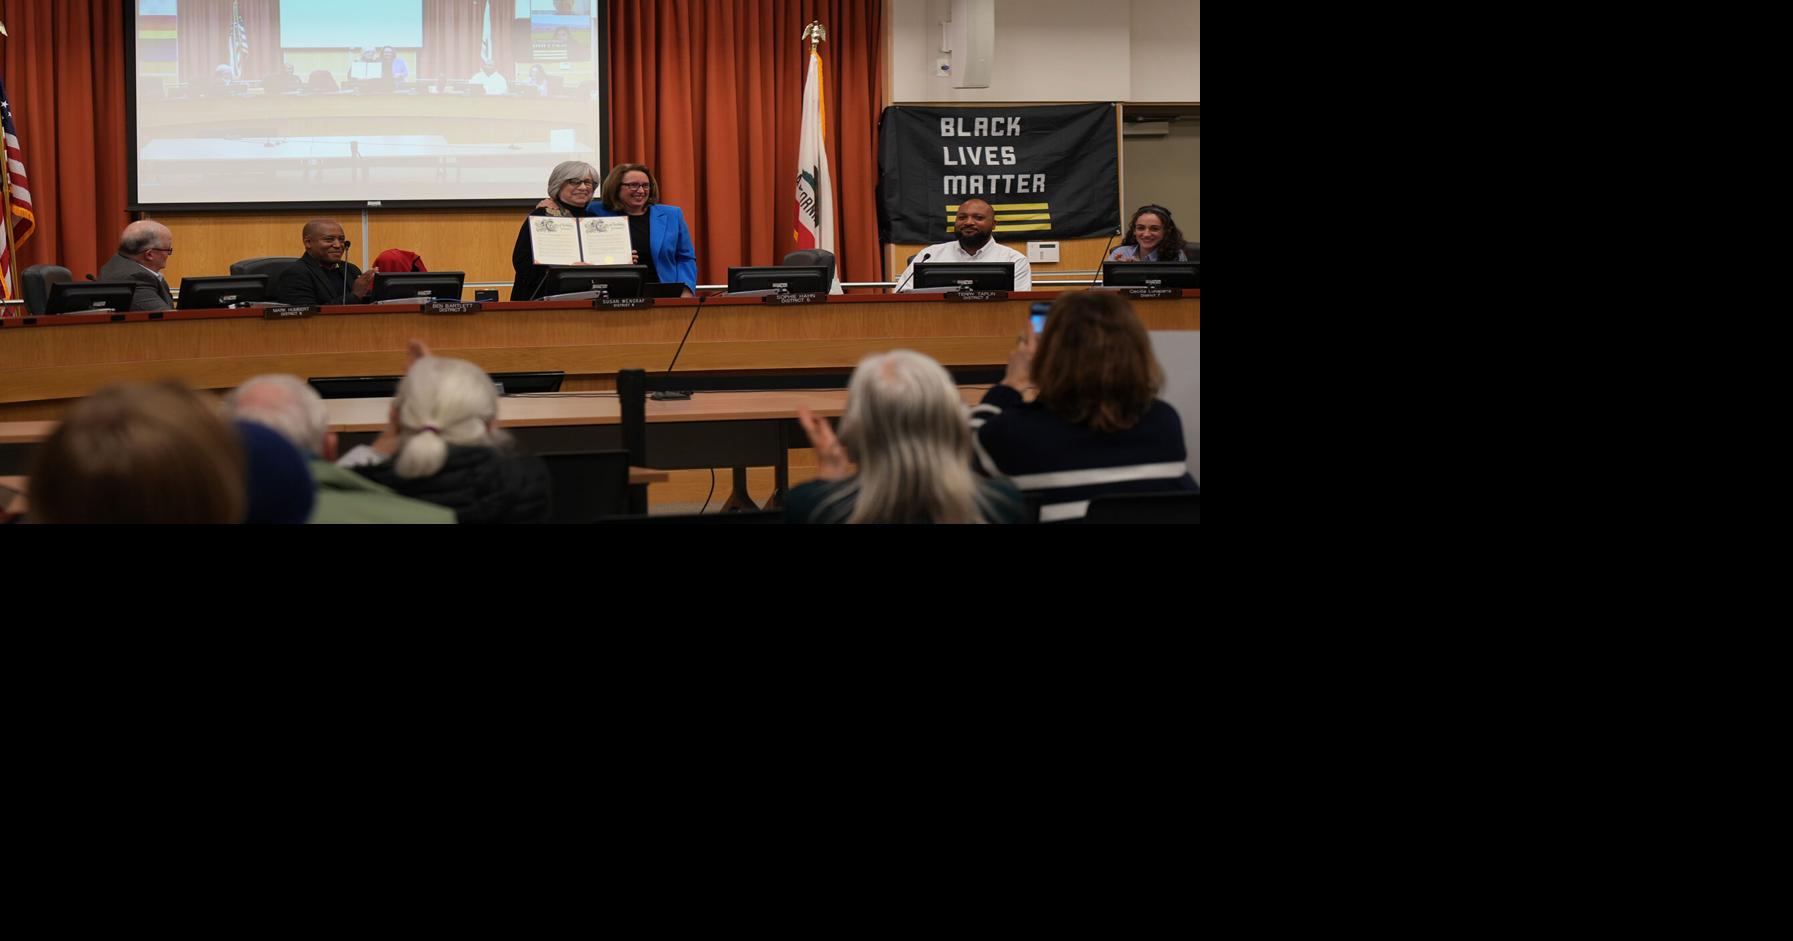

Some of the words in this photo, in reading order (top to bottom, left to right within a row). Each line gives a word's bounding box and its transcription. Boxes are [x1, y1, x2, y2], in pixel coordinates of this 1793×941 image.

[940, 116, 1021, 137] BLACK
[943, 146, 1017, 166] LIVES
[943, 173, 1046, 195] MATTER
